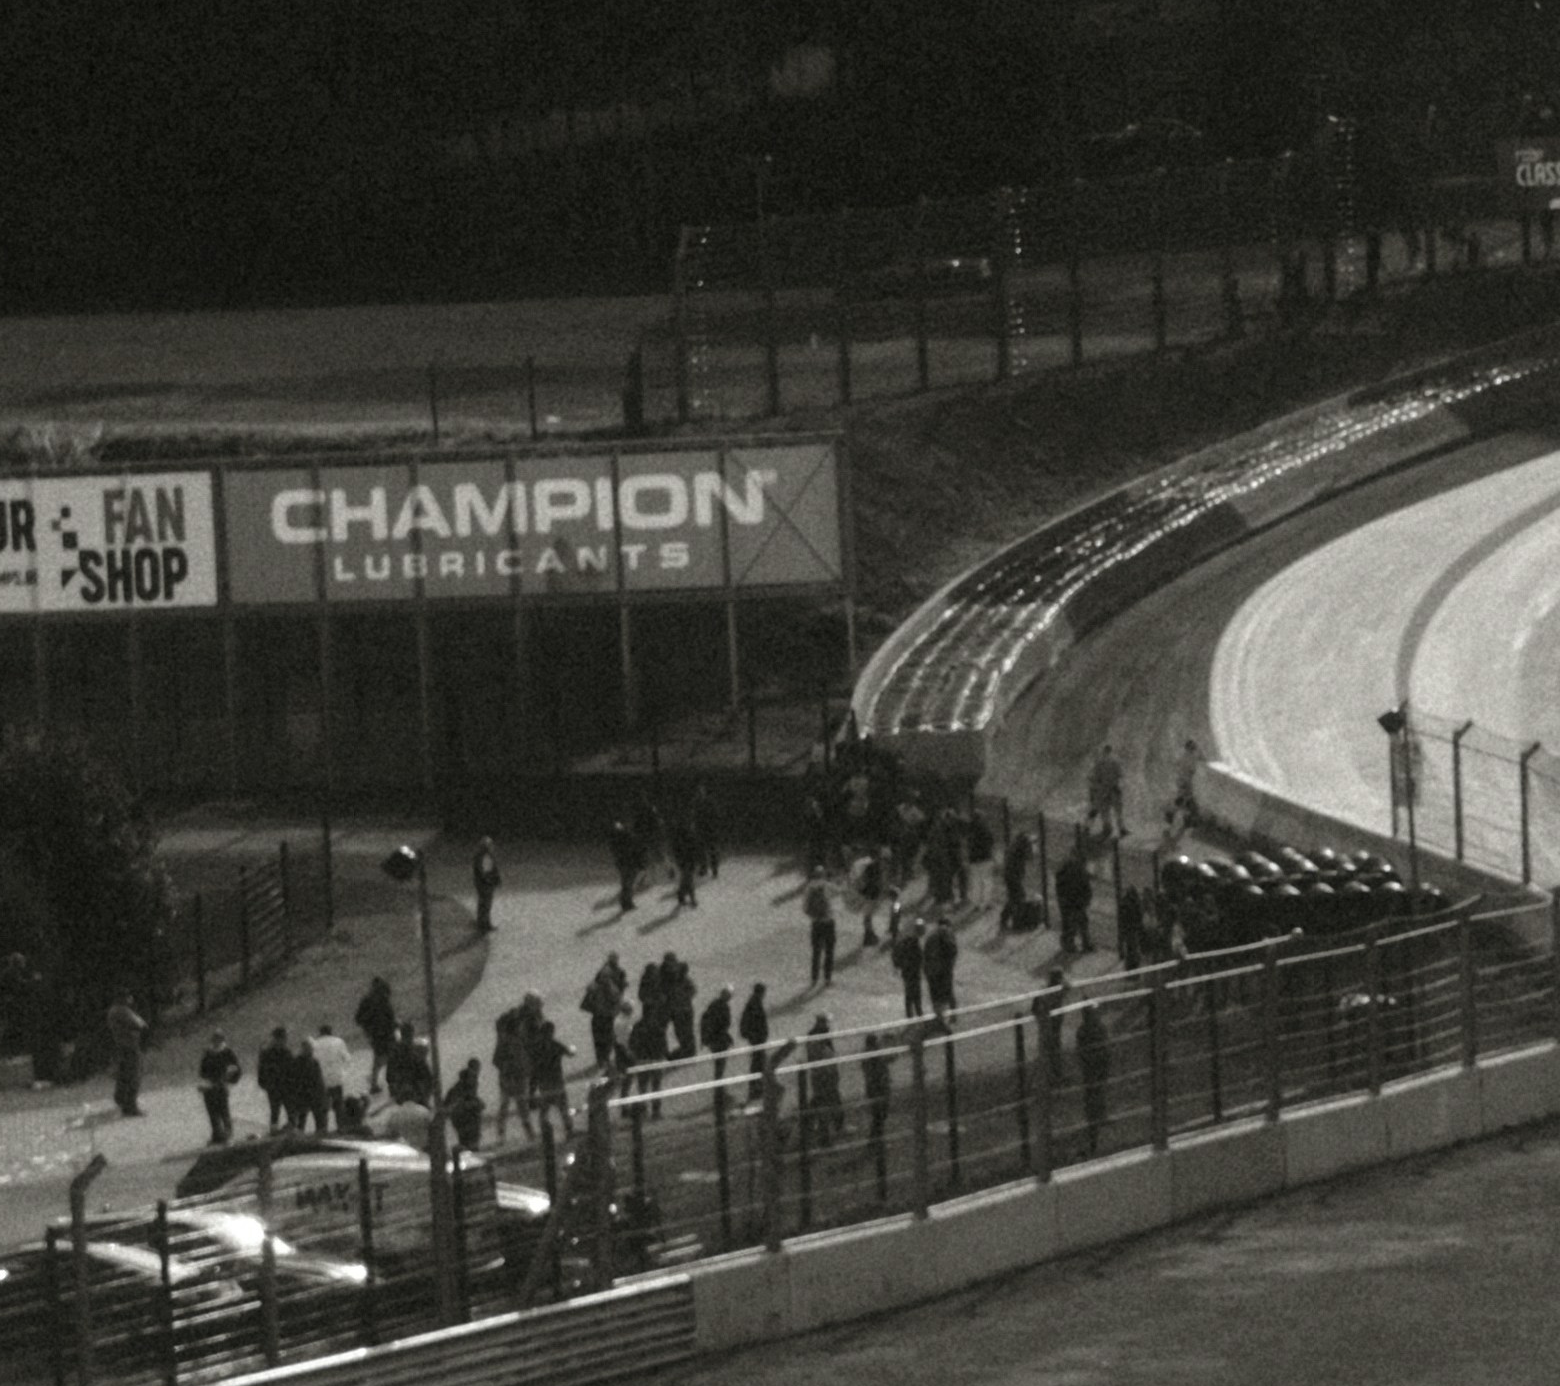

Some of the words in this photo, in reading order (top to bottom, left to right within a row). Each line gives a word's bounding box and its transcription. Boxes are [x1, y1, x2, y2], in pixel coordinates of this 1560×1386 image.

[102, 487, 186, 545] FAN
[270, 470, 775, 546] CHAMPION
[78, 547, 189, 603] SHOP
[333, 543, 689, 582] LUBRICANTS
